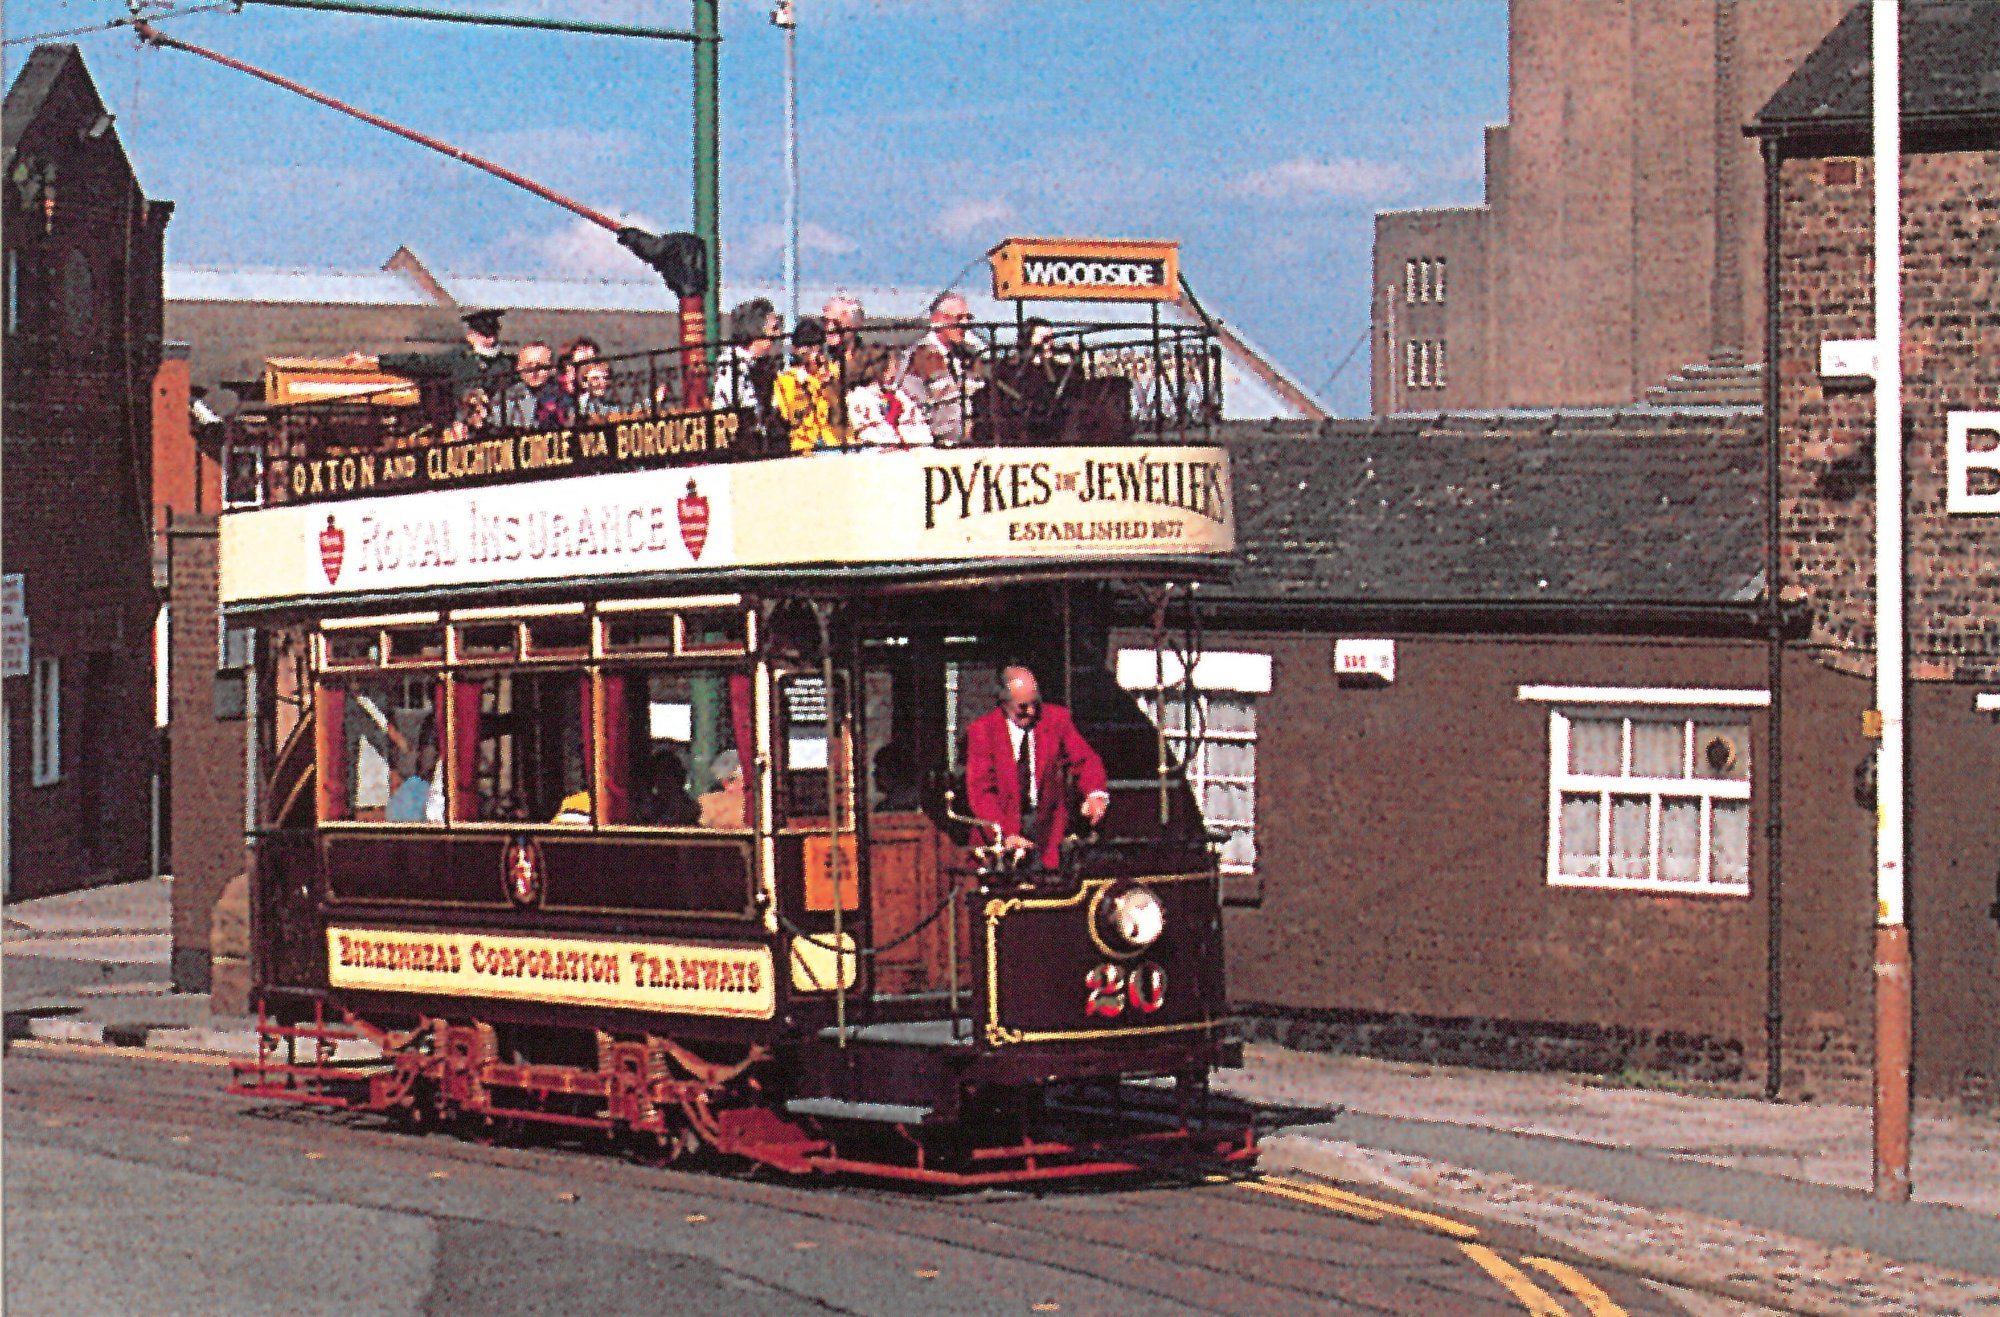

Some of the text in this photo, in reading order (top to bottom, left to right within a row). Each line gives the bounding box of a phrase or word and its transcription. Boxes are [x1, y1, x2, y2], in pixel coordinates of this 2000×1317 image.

[1024, 260, 1154, 286] WOODSIDE
[292, 454, 375, 497] OXTON
[382, 454, 416, 481] AND
[519, 430, 574, 469] CIRCLE
[579, 431, 608, 458] VIA
[616, 415, 707, 460] BOROUGH
[922, 457, 1052, 530] PYKES
[358, 500, 667, 573] ROYAL INSURANCE
[1008, 520, 1149, 542] ESTABLISHED
[470, 940, 620, 985] CORPORATION
[630, 951, 761, 994] TRAMWAYS
[1085, 960, 1168, 1018] 20
